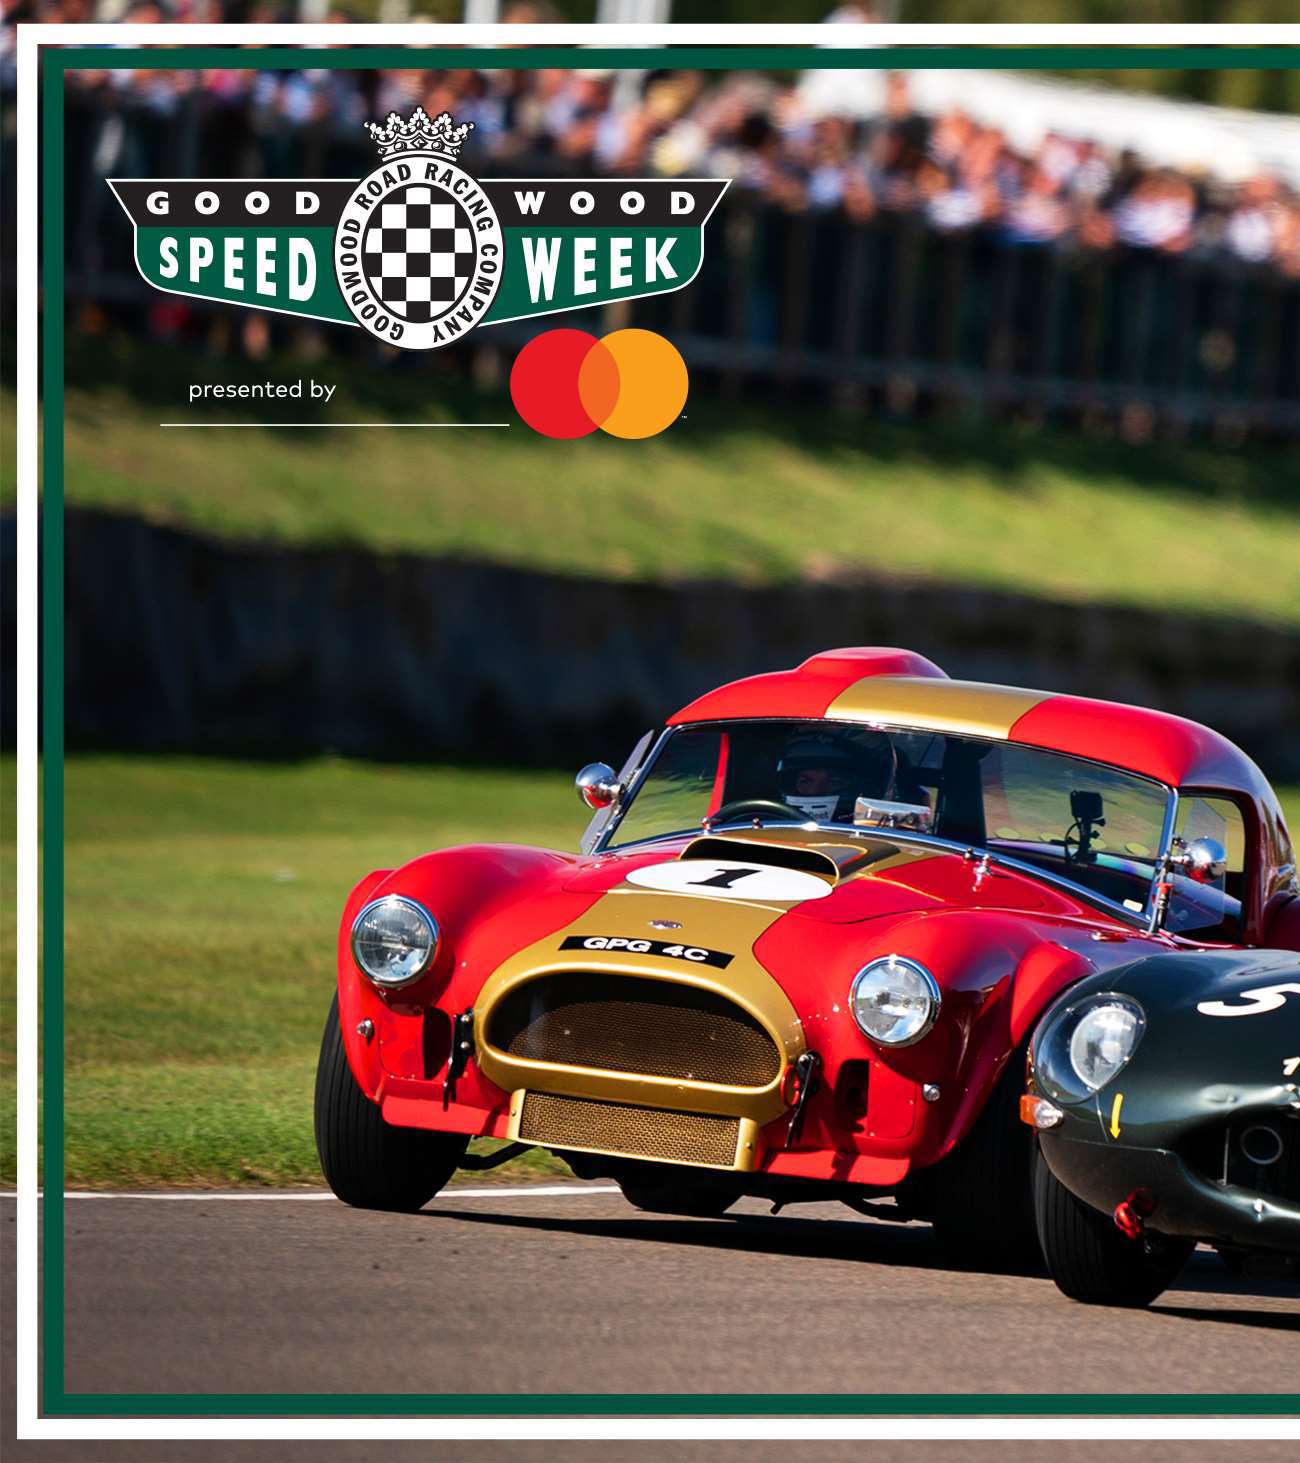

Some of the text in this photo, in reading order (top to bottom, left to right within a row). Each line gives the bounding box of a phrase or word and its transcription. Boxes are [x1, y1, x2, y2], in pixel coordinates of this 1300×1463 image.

[686, 868, 763, 889] 1
[583, 937, 709, 961] GPG 4C
